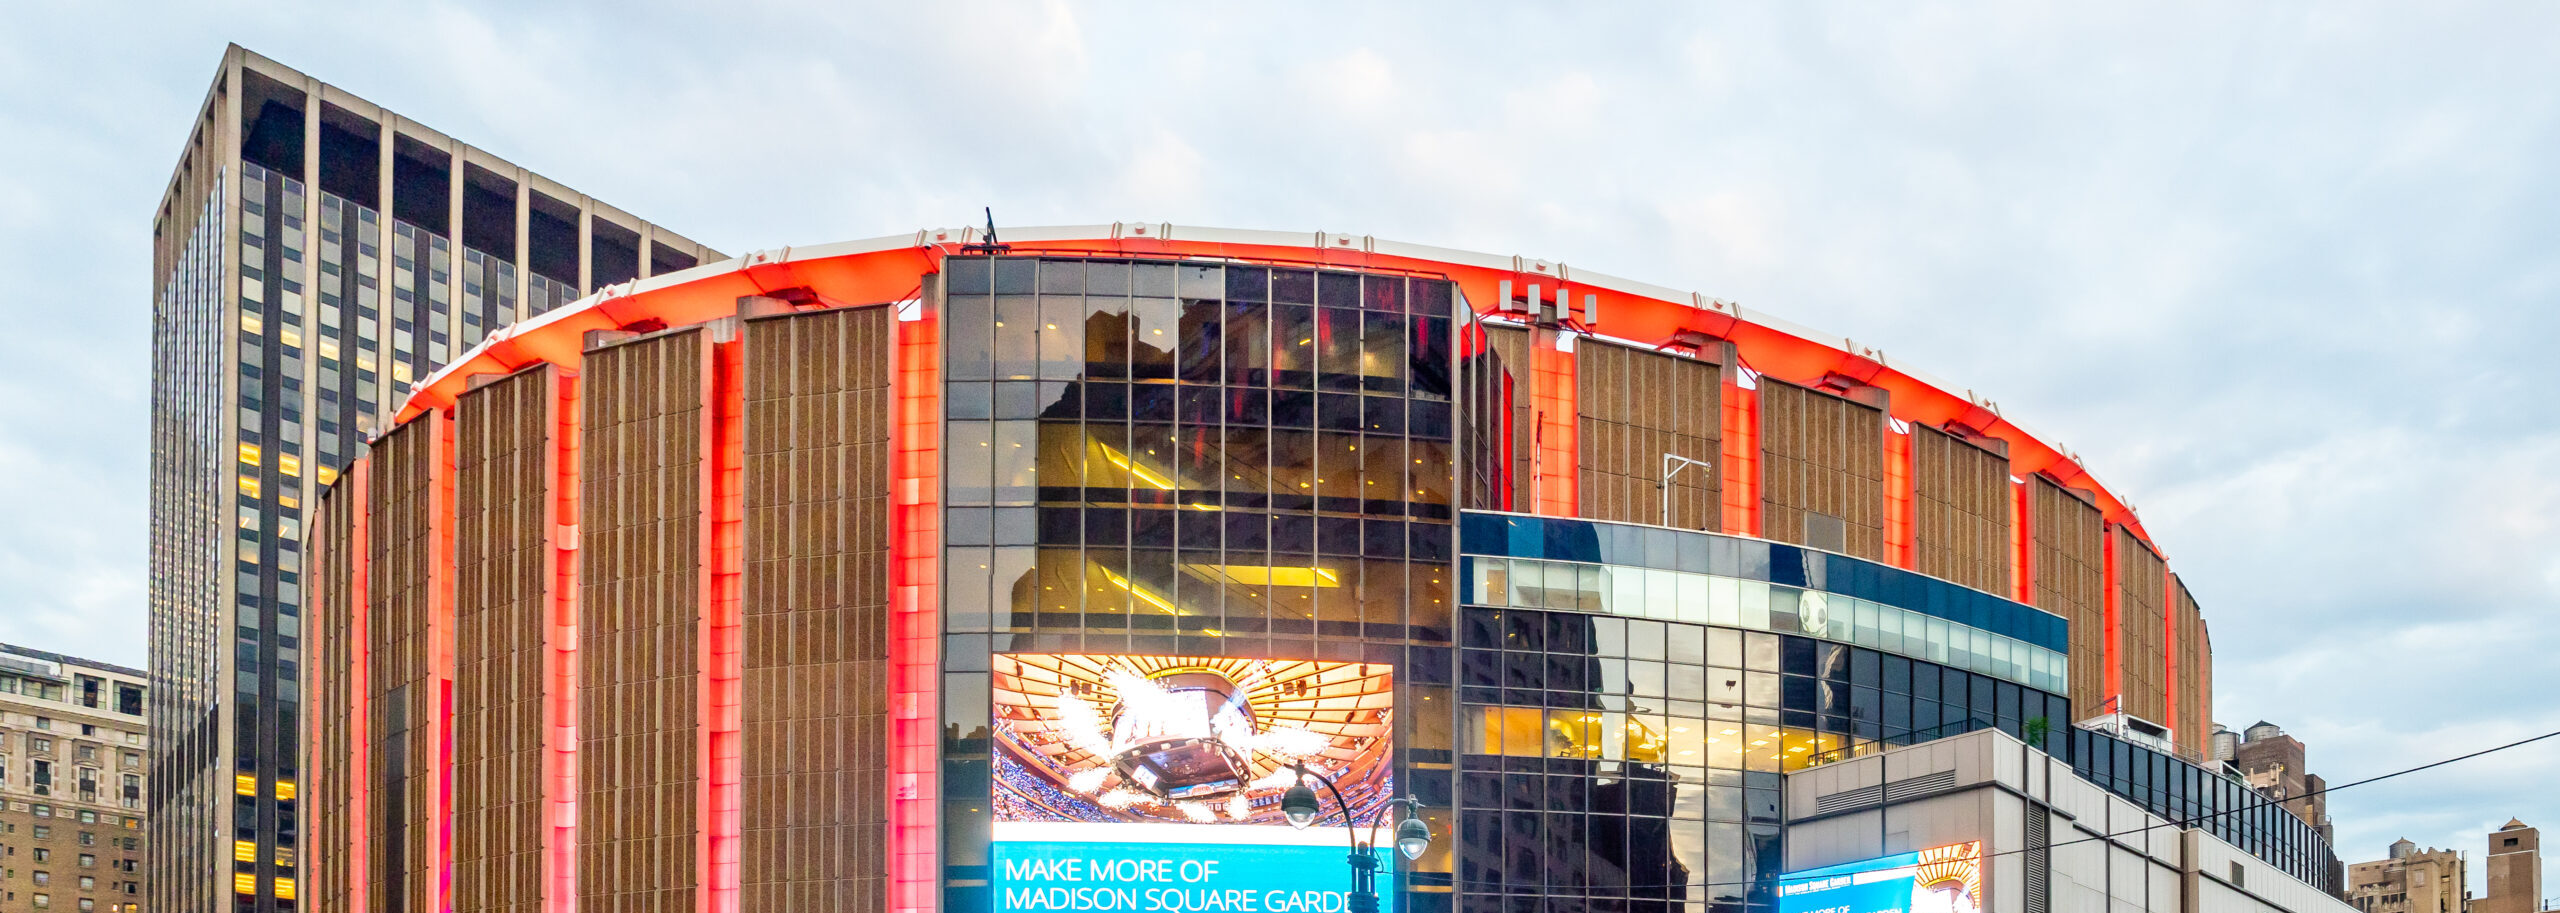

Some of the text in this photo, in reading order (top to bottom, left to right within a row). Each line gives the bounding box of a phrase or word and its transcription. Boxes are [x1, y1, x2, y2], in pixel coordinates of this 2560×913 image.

[1005, 858, 1219, 883] MAKE MORE OF
[1005, 887, 1353, 913] MADISON SQUARE GARDE
